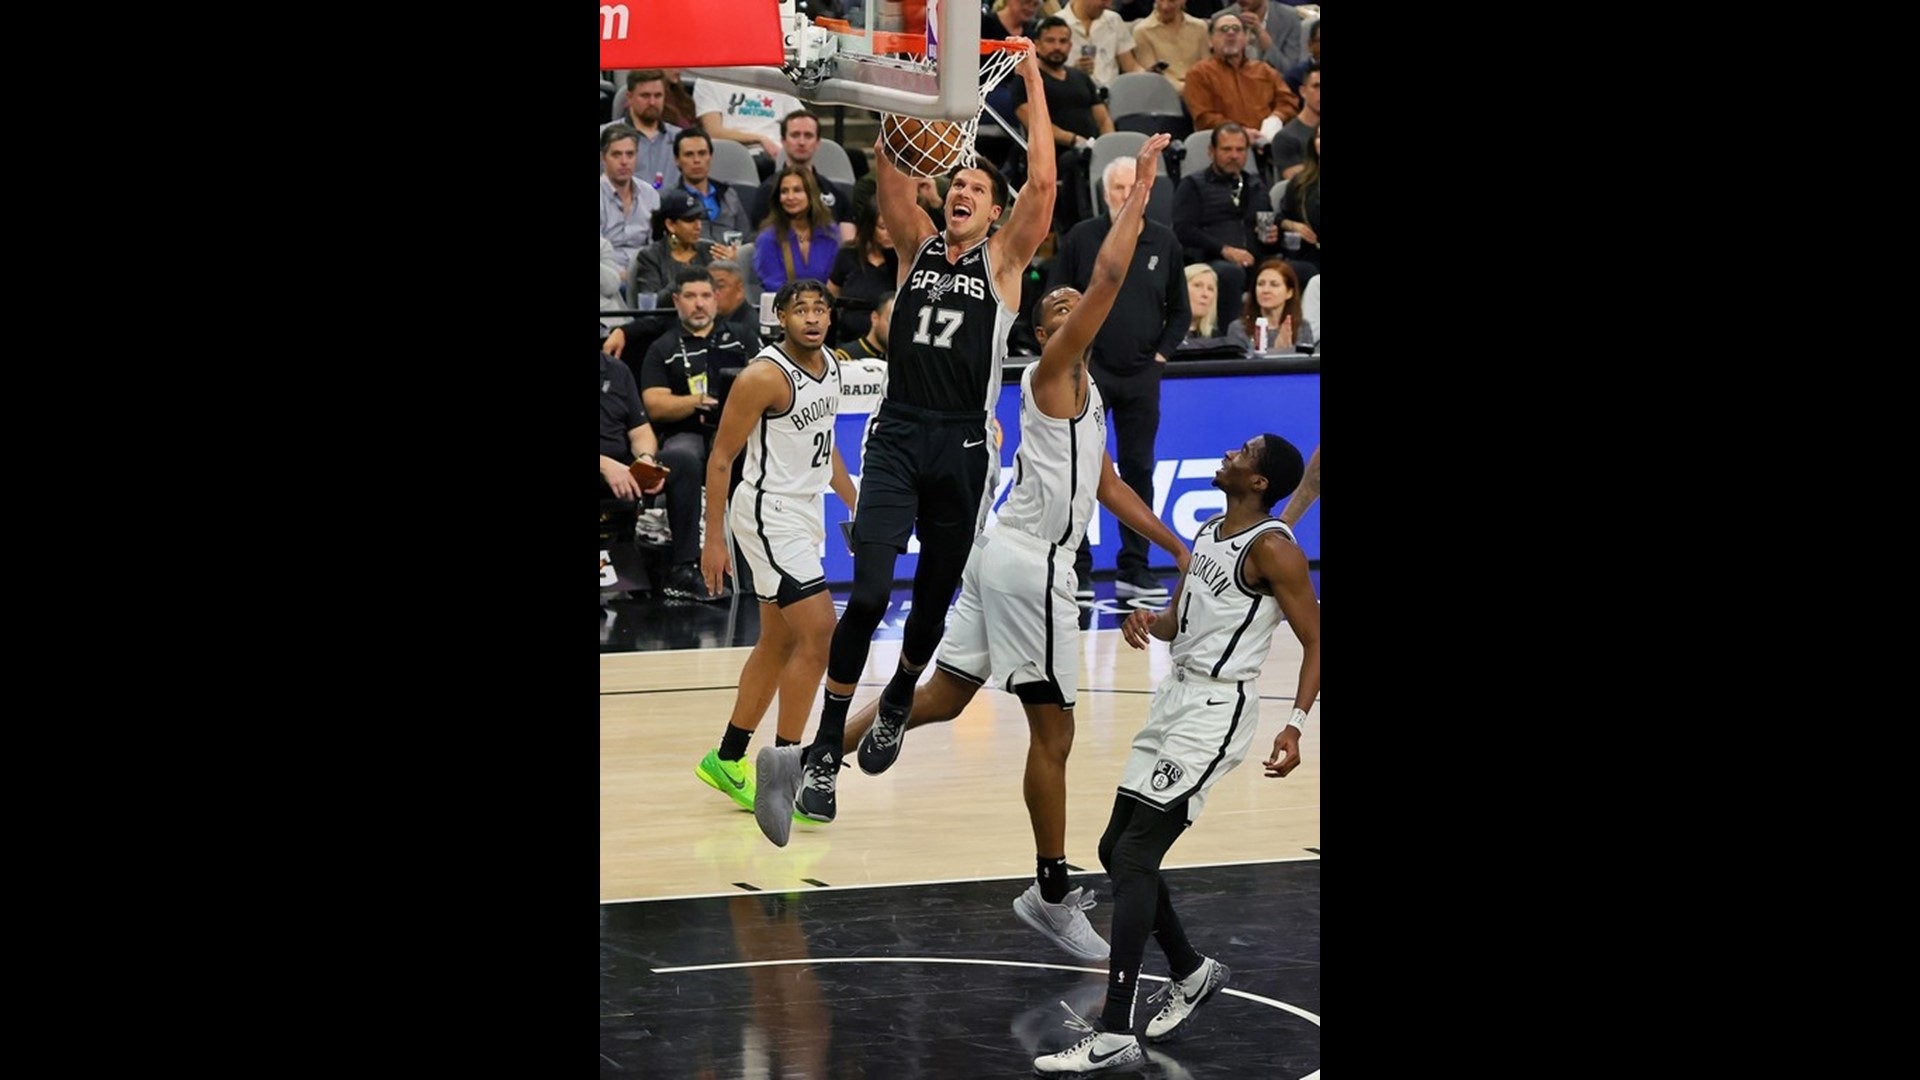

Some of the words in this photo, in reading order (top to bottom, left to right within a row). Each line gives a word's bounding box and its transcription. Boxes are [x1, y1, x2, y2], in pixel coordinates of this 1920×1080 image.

[912, 305, 965, 349] 17
[840, 384, 881, 396] RADE
[811, 429, 832, 468] 24
[1189, 552, 1232, 597] OOKLYN
